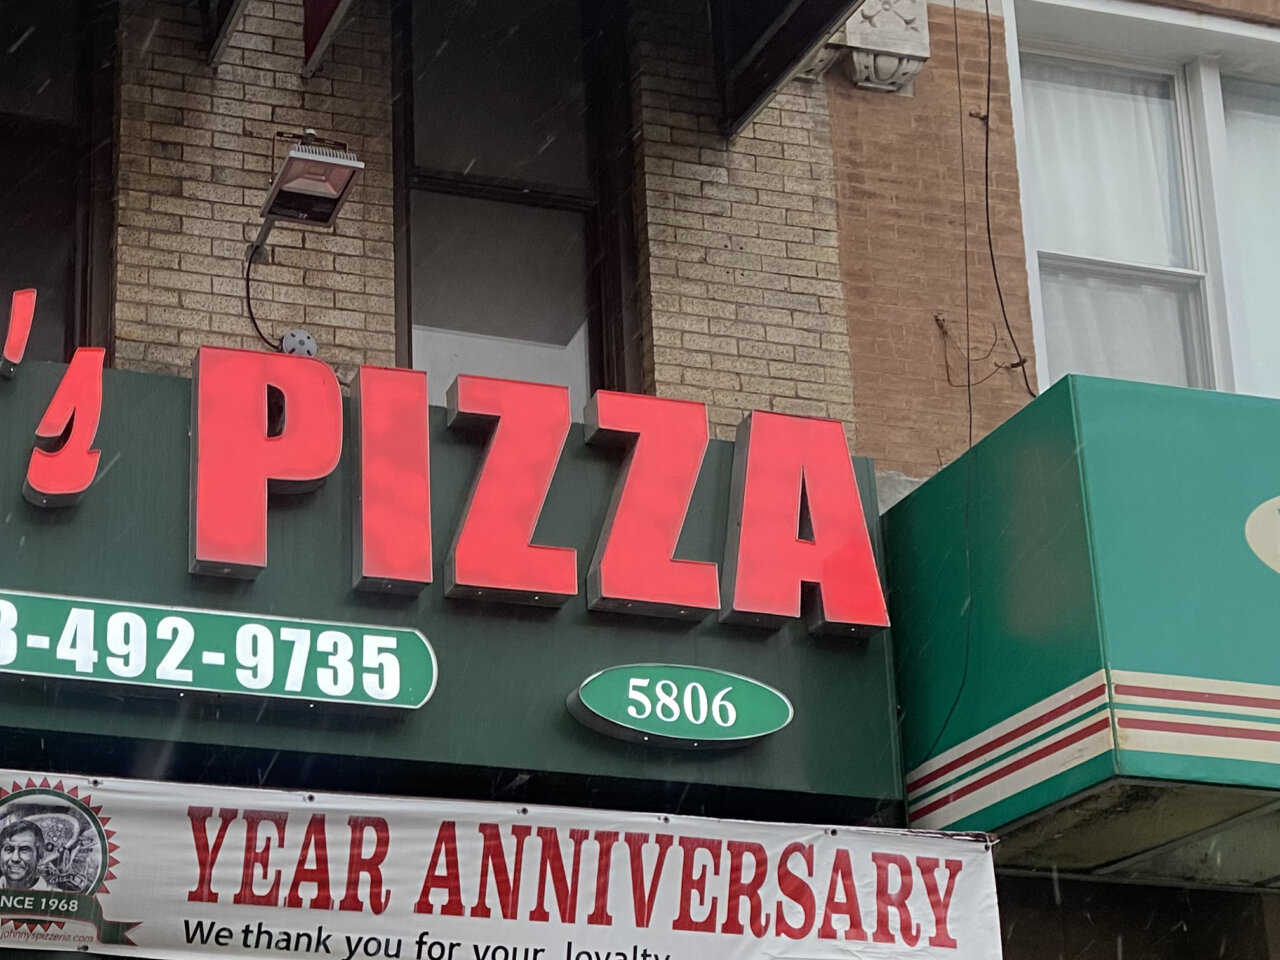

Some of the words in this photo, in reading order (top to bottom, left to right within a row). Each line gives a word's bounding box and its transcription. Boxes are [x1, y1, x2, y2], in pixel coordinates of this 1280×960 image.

[192, 345, 890, 628] PIZZA
[625, 677, 738, 728] 5806
[186, 804, 392, 916] YEAR
[413, 819, 963, 949] ANNIVERSARY
[40, 897, 79, 913] 1968
[182, 918, 234, 948] We
[240, 921, 332, 956] thank
